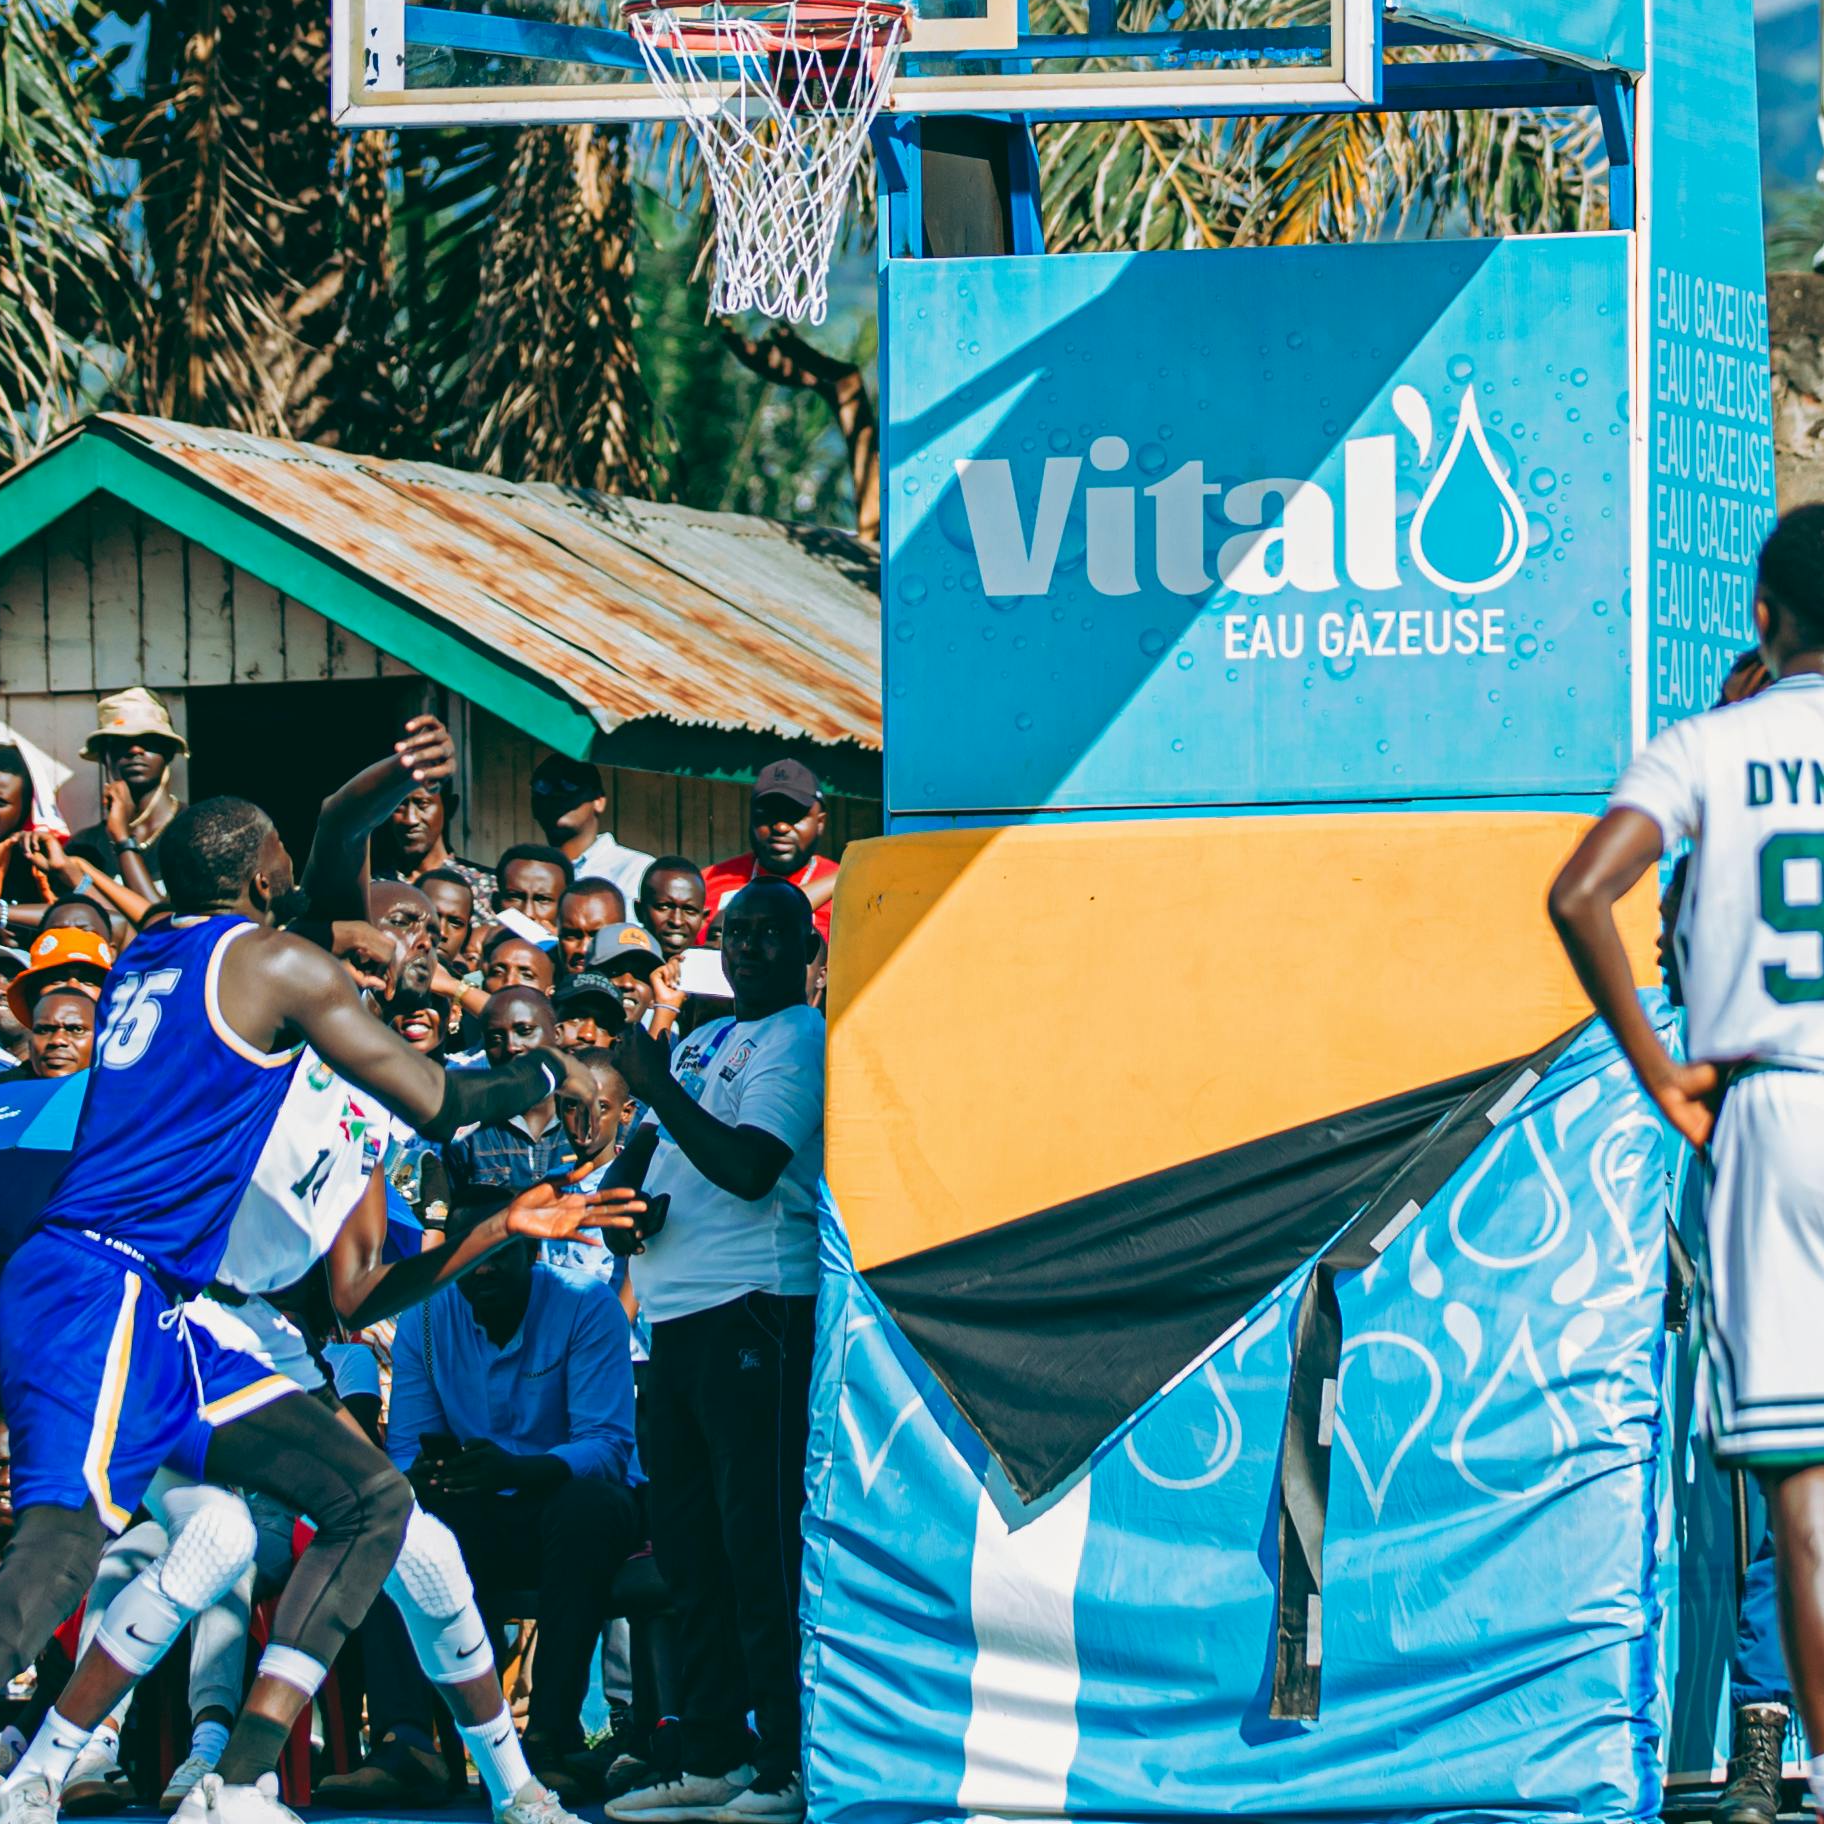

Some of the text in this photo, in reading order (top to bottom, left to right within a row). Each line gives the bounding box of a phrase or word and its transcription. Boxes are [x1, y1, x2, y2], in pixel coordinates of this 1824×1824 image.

[1657, 267, 1767, 354] EAU GAZEUSE
[1657, 340, 1768, 426] EAU GAZEUSE
[1657, 411, 1770, 497] EAU GAZEUSE
[1657, 484, 1691, 554] EAU
[1226, 608, 1506, 660] EAU GAZEUSE
[1656, 560, 1754, 643] EAU GAZEU
[1656, 636, 1694, 711] EAU
